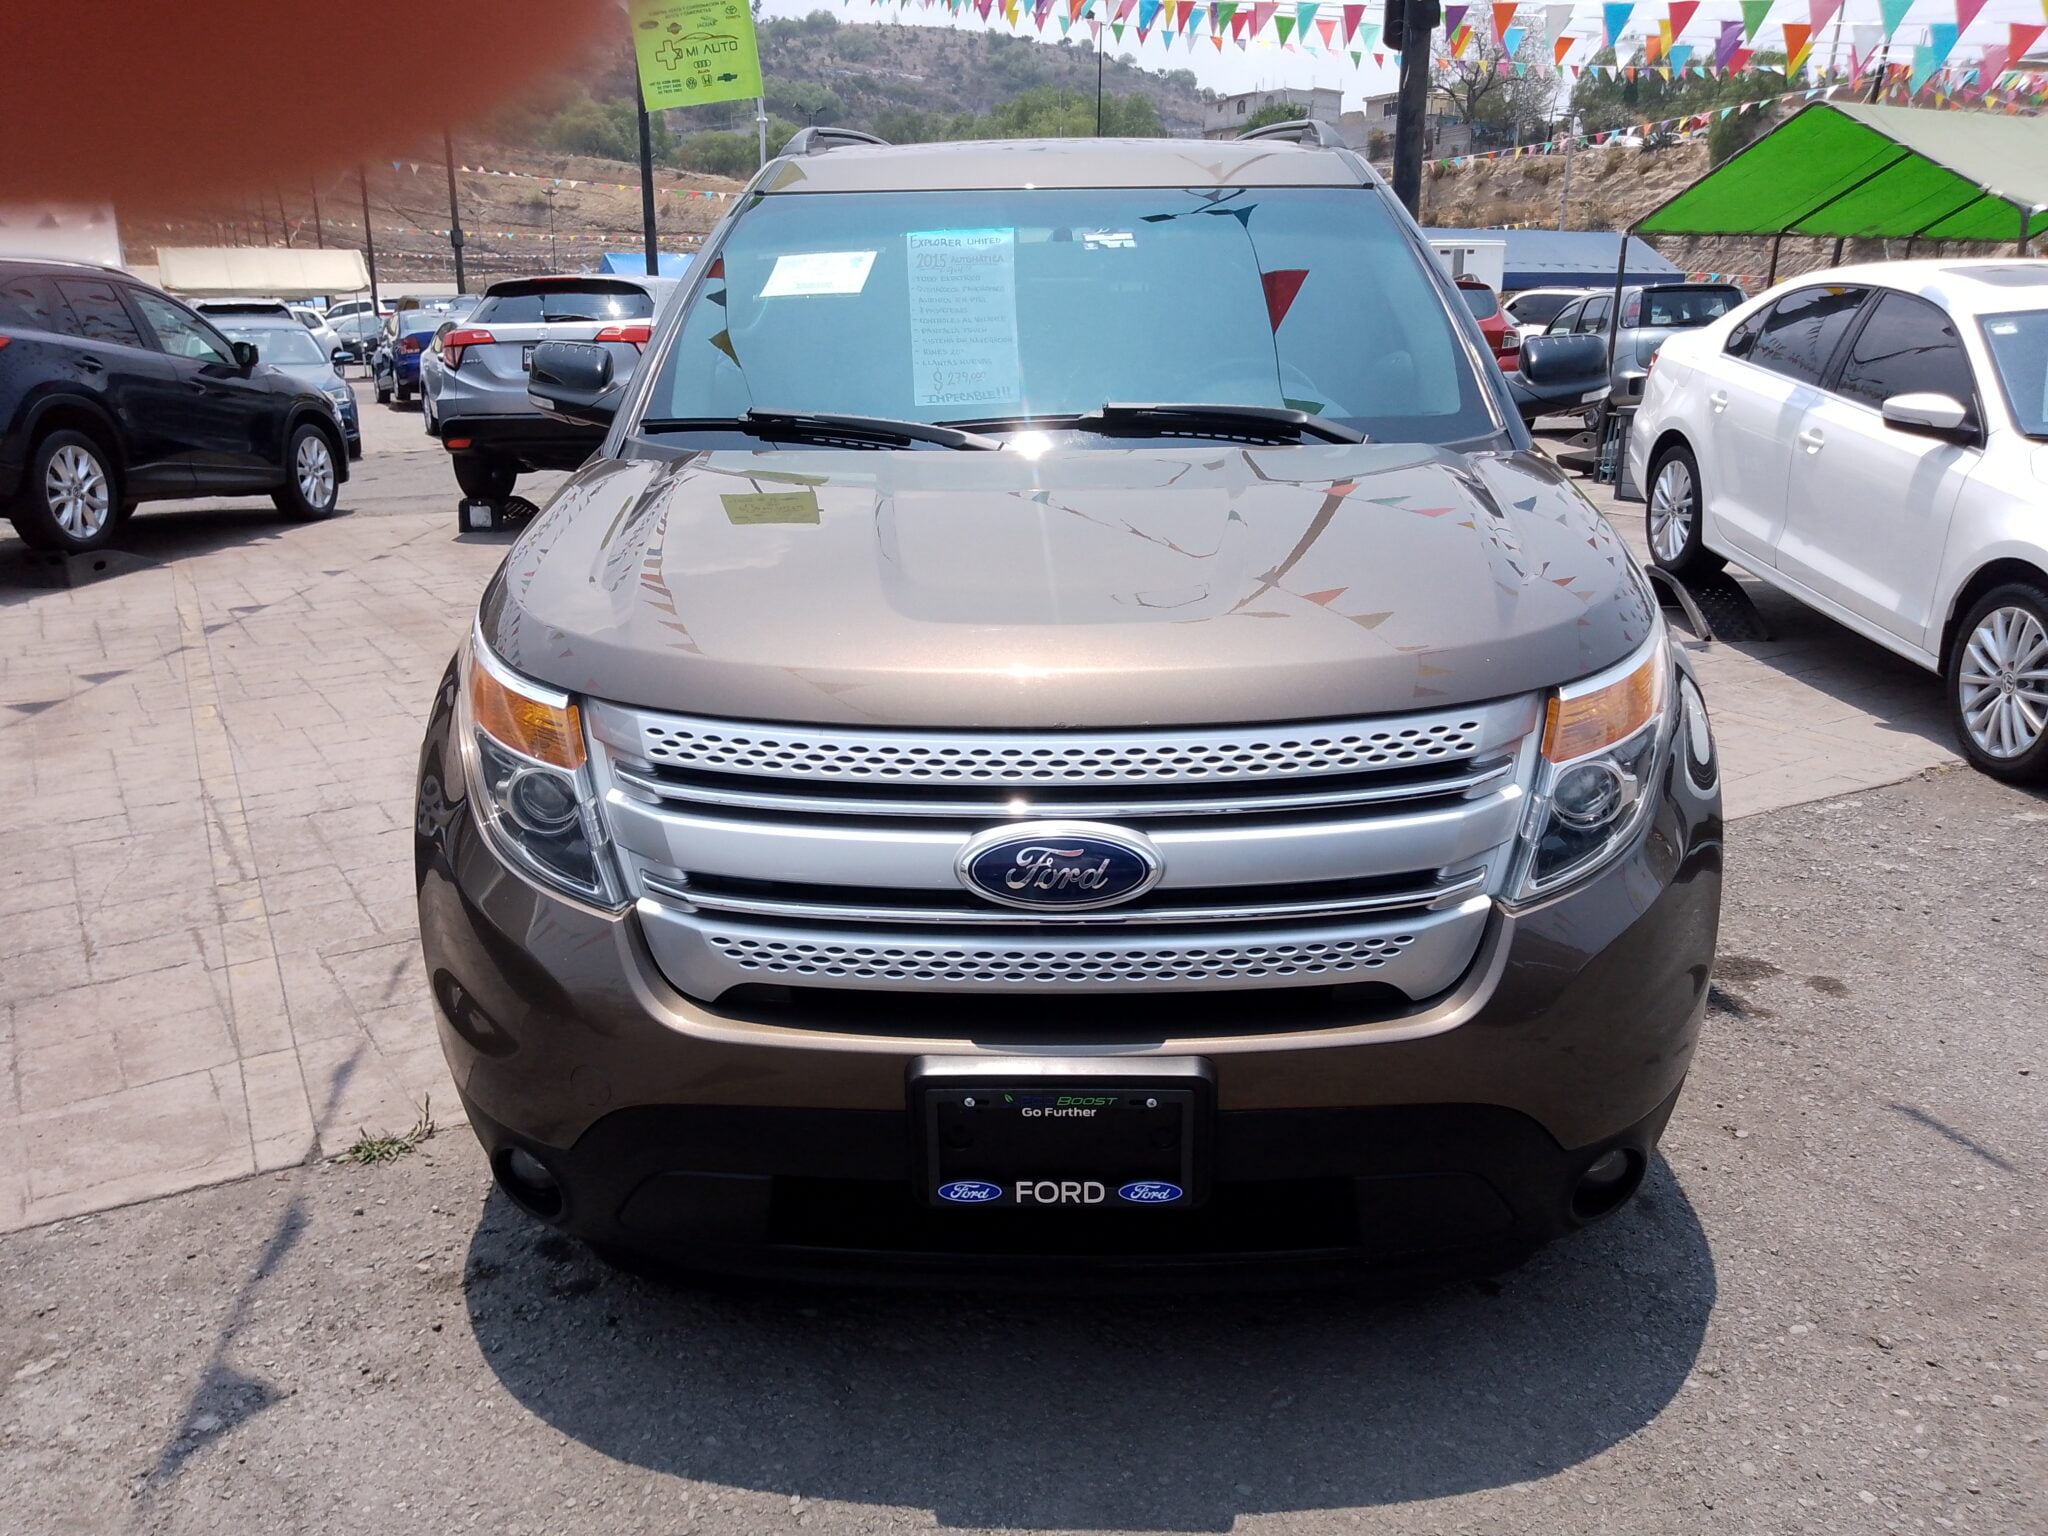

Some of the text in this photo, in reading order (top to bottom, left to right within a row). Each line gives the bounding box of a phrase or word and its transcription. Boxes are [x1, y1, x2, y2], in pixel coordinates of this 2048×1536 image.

[686, 41, 738, 57] MI AUTO
[911, 235, 961, 248] EXPLORER
[917, 253, 947, 268] 2015
[1005, 846, 1110, 890] Ford
[1021, 1107, 1097, 1117] Go Further
[950, 1184, 990, 1200] Ford
[1015, 1181, 1106, 1204] FORD
[1130, 1184, 1171, 1200] Ford
